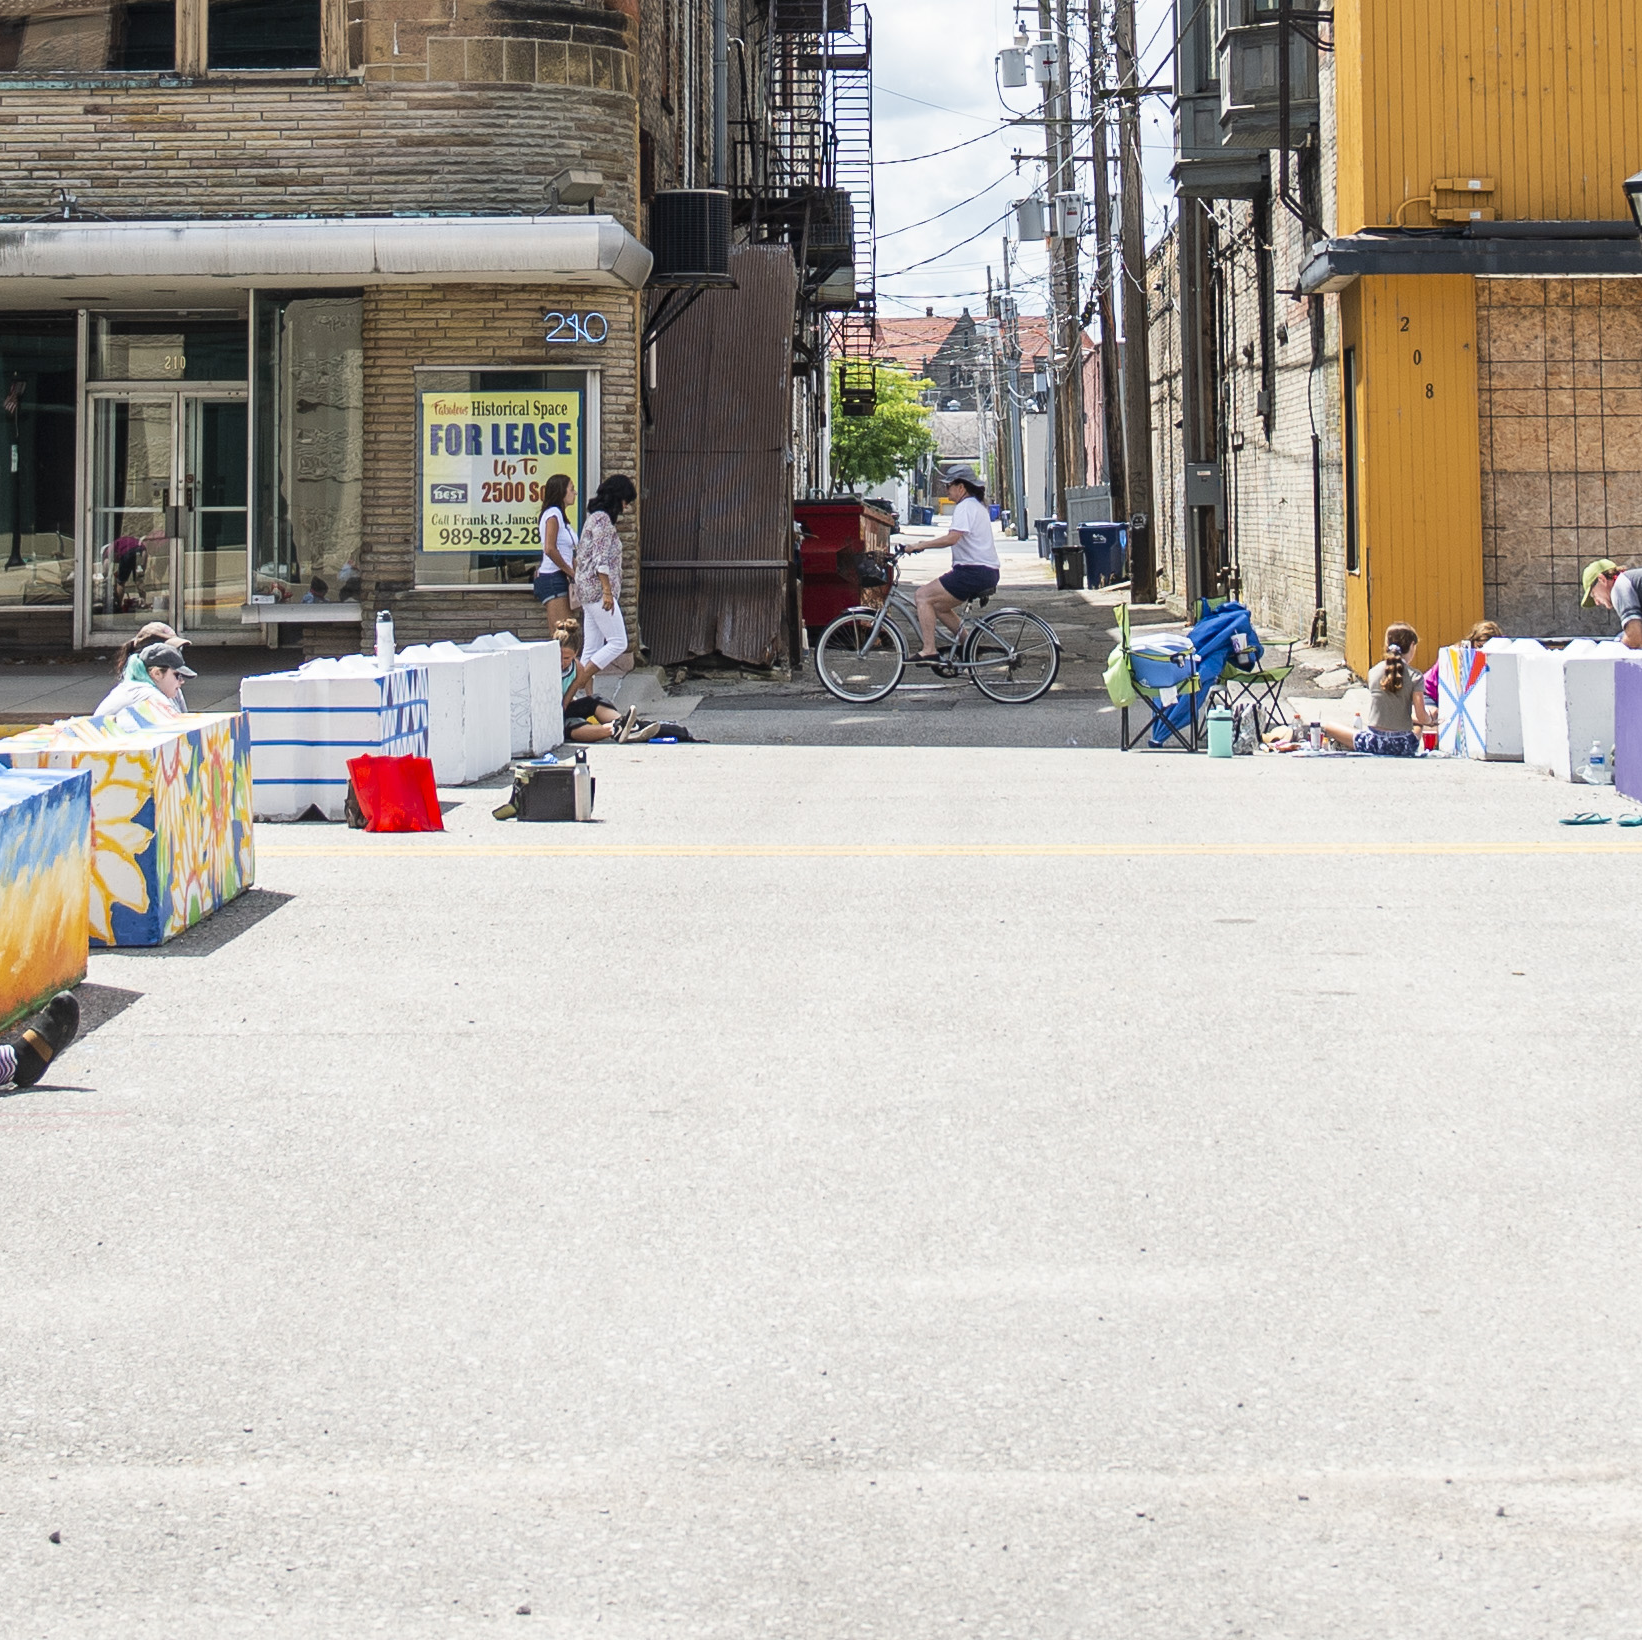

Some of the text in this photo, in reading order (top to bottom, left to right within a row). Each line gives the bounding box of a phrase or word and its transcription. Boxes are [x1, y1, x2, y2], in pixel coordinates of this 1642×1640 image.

[544, 312, 608, 343] 210
[164, 355, 187, 370] 210
[471, 400, 530, 416] Historical
[533, 400, 568, 419] Space
[430, 422, 572, 456] FOR LEASE
[493, 458, 538, 480] Up To
[481, 481, 526, 503] 2500
[431, 513, 538, 526] Call Frank R. Janca
[439, 527, 541, 545] 989-892-28
